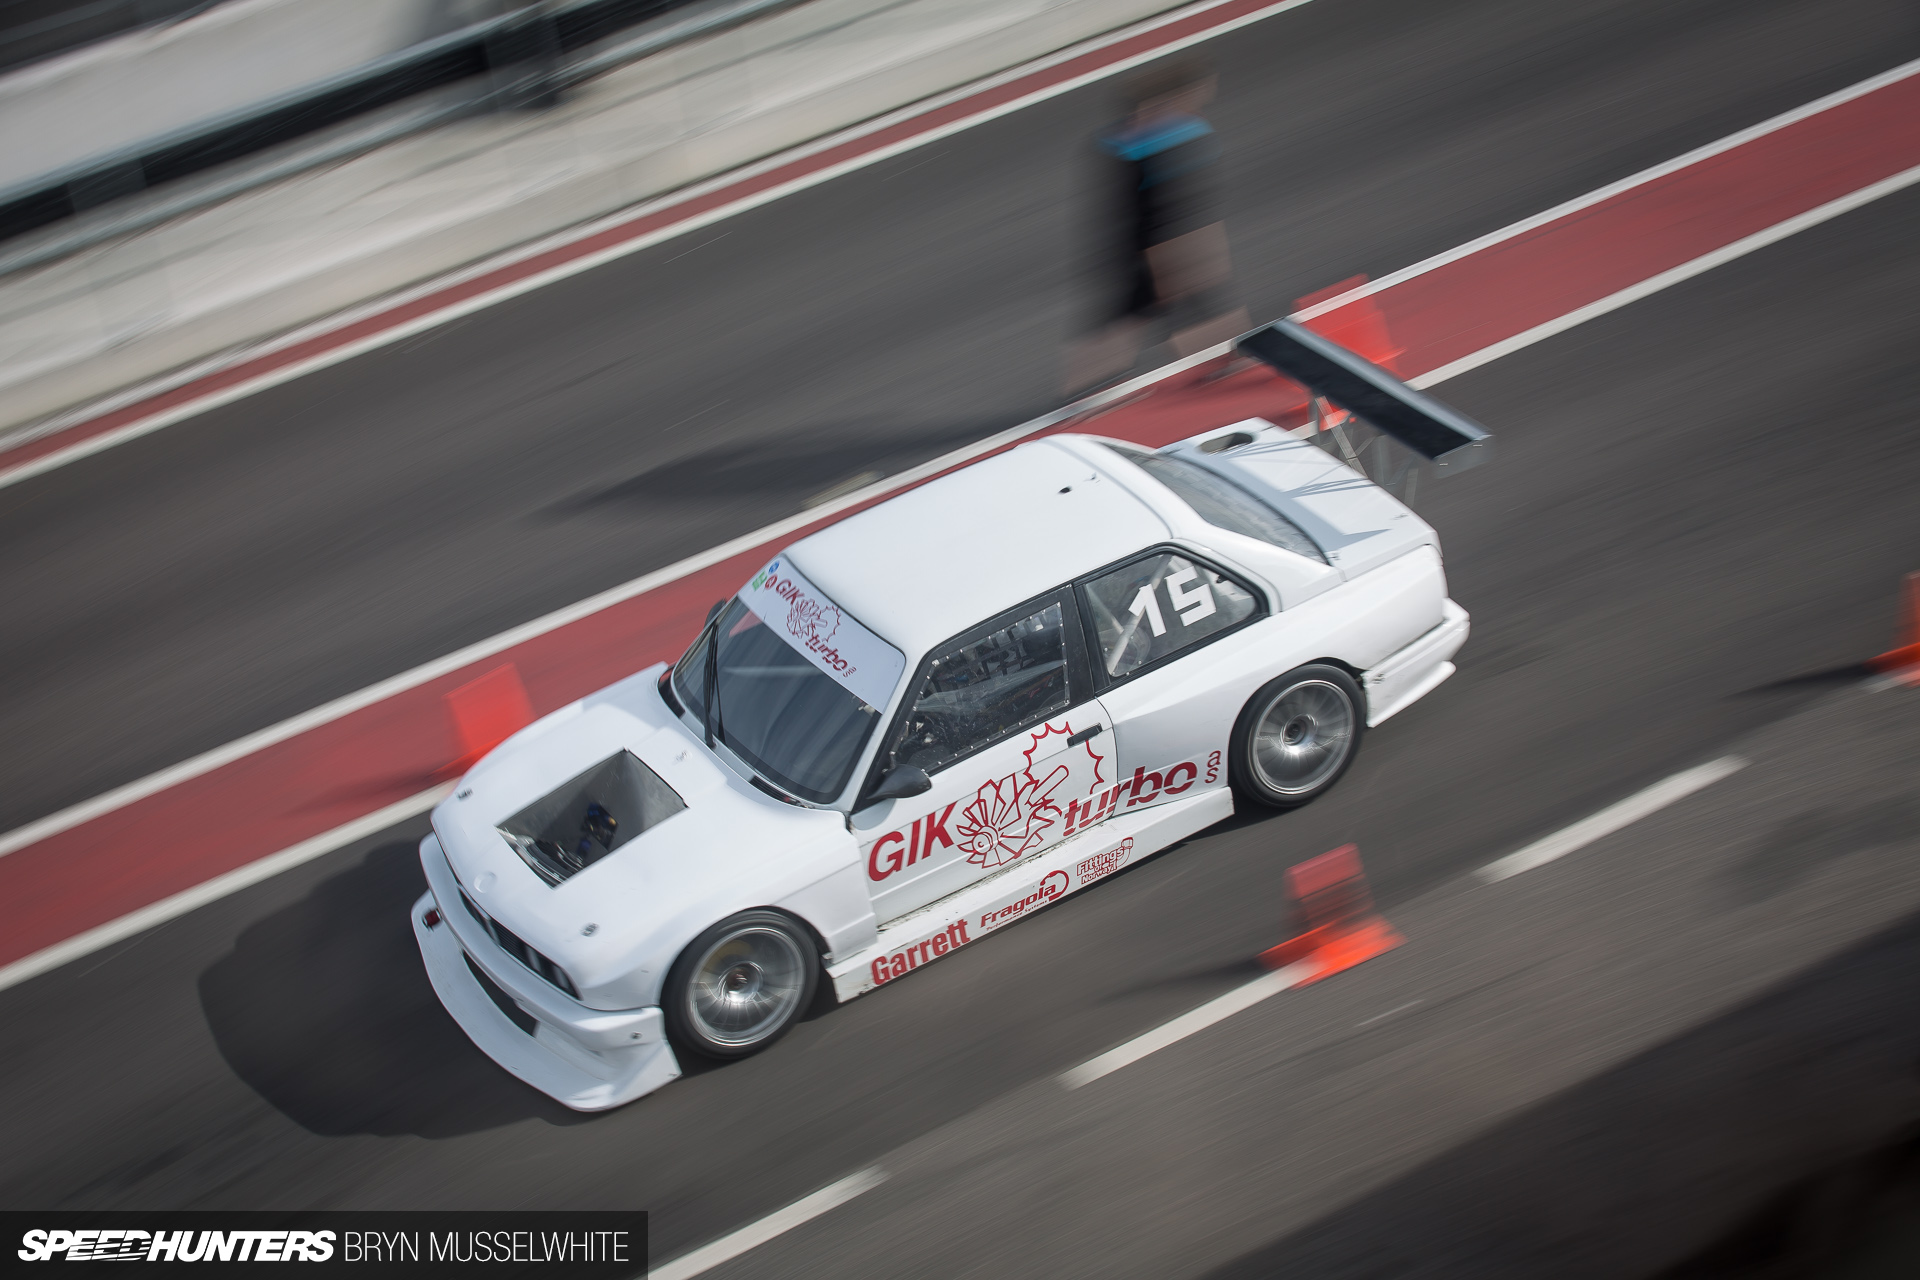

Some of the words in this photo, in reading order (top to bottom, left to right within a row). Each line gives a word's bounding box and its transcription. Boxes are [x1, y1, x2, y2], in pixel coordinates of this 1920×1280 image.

[776, 579, 805, 605] GIK
[805, 634, 848, 671] turbo
[1128, 566, 1217, 638] 15
[867, 801, 958, 882] GIK
[1063, 761, 1198, 836] turbo
[1076, 846, 1124, 876] Fittings
[1081, 864, 1113, 884] Norway
[980, 884, 1056, 928] Fragola
[871, 919, 970, 985] Garrett
